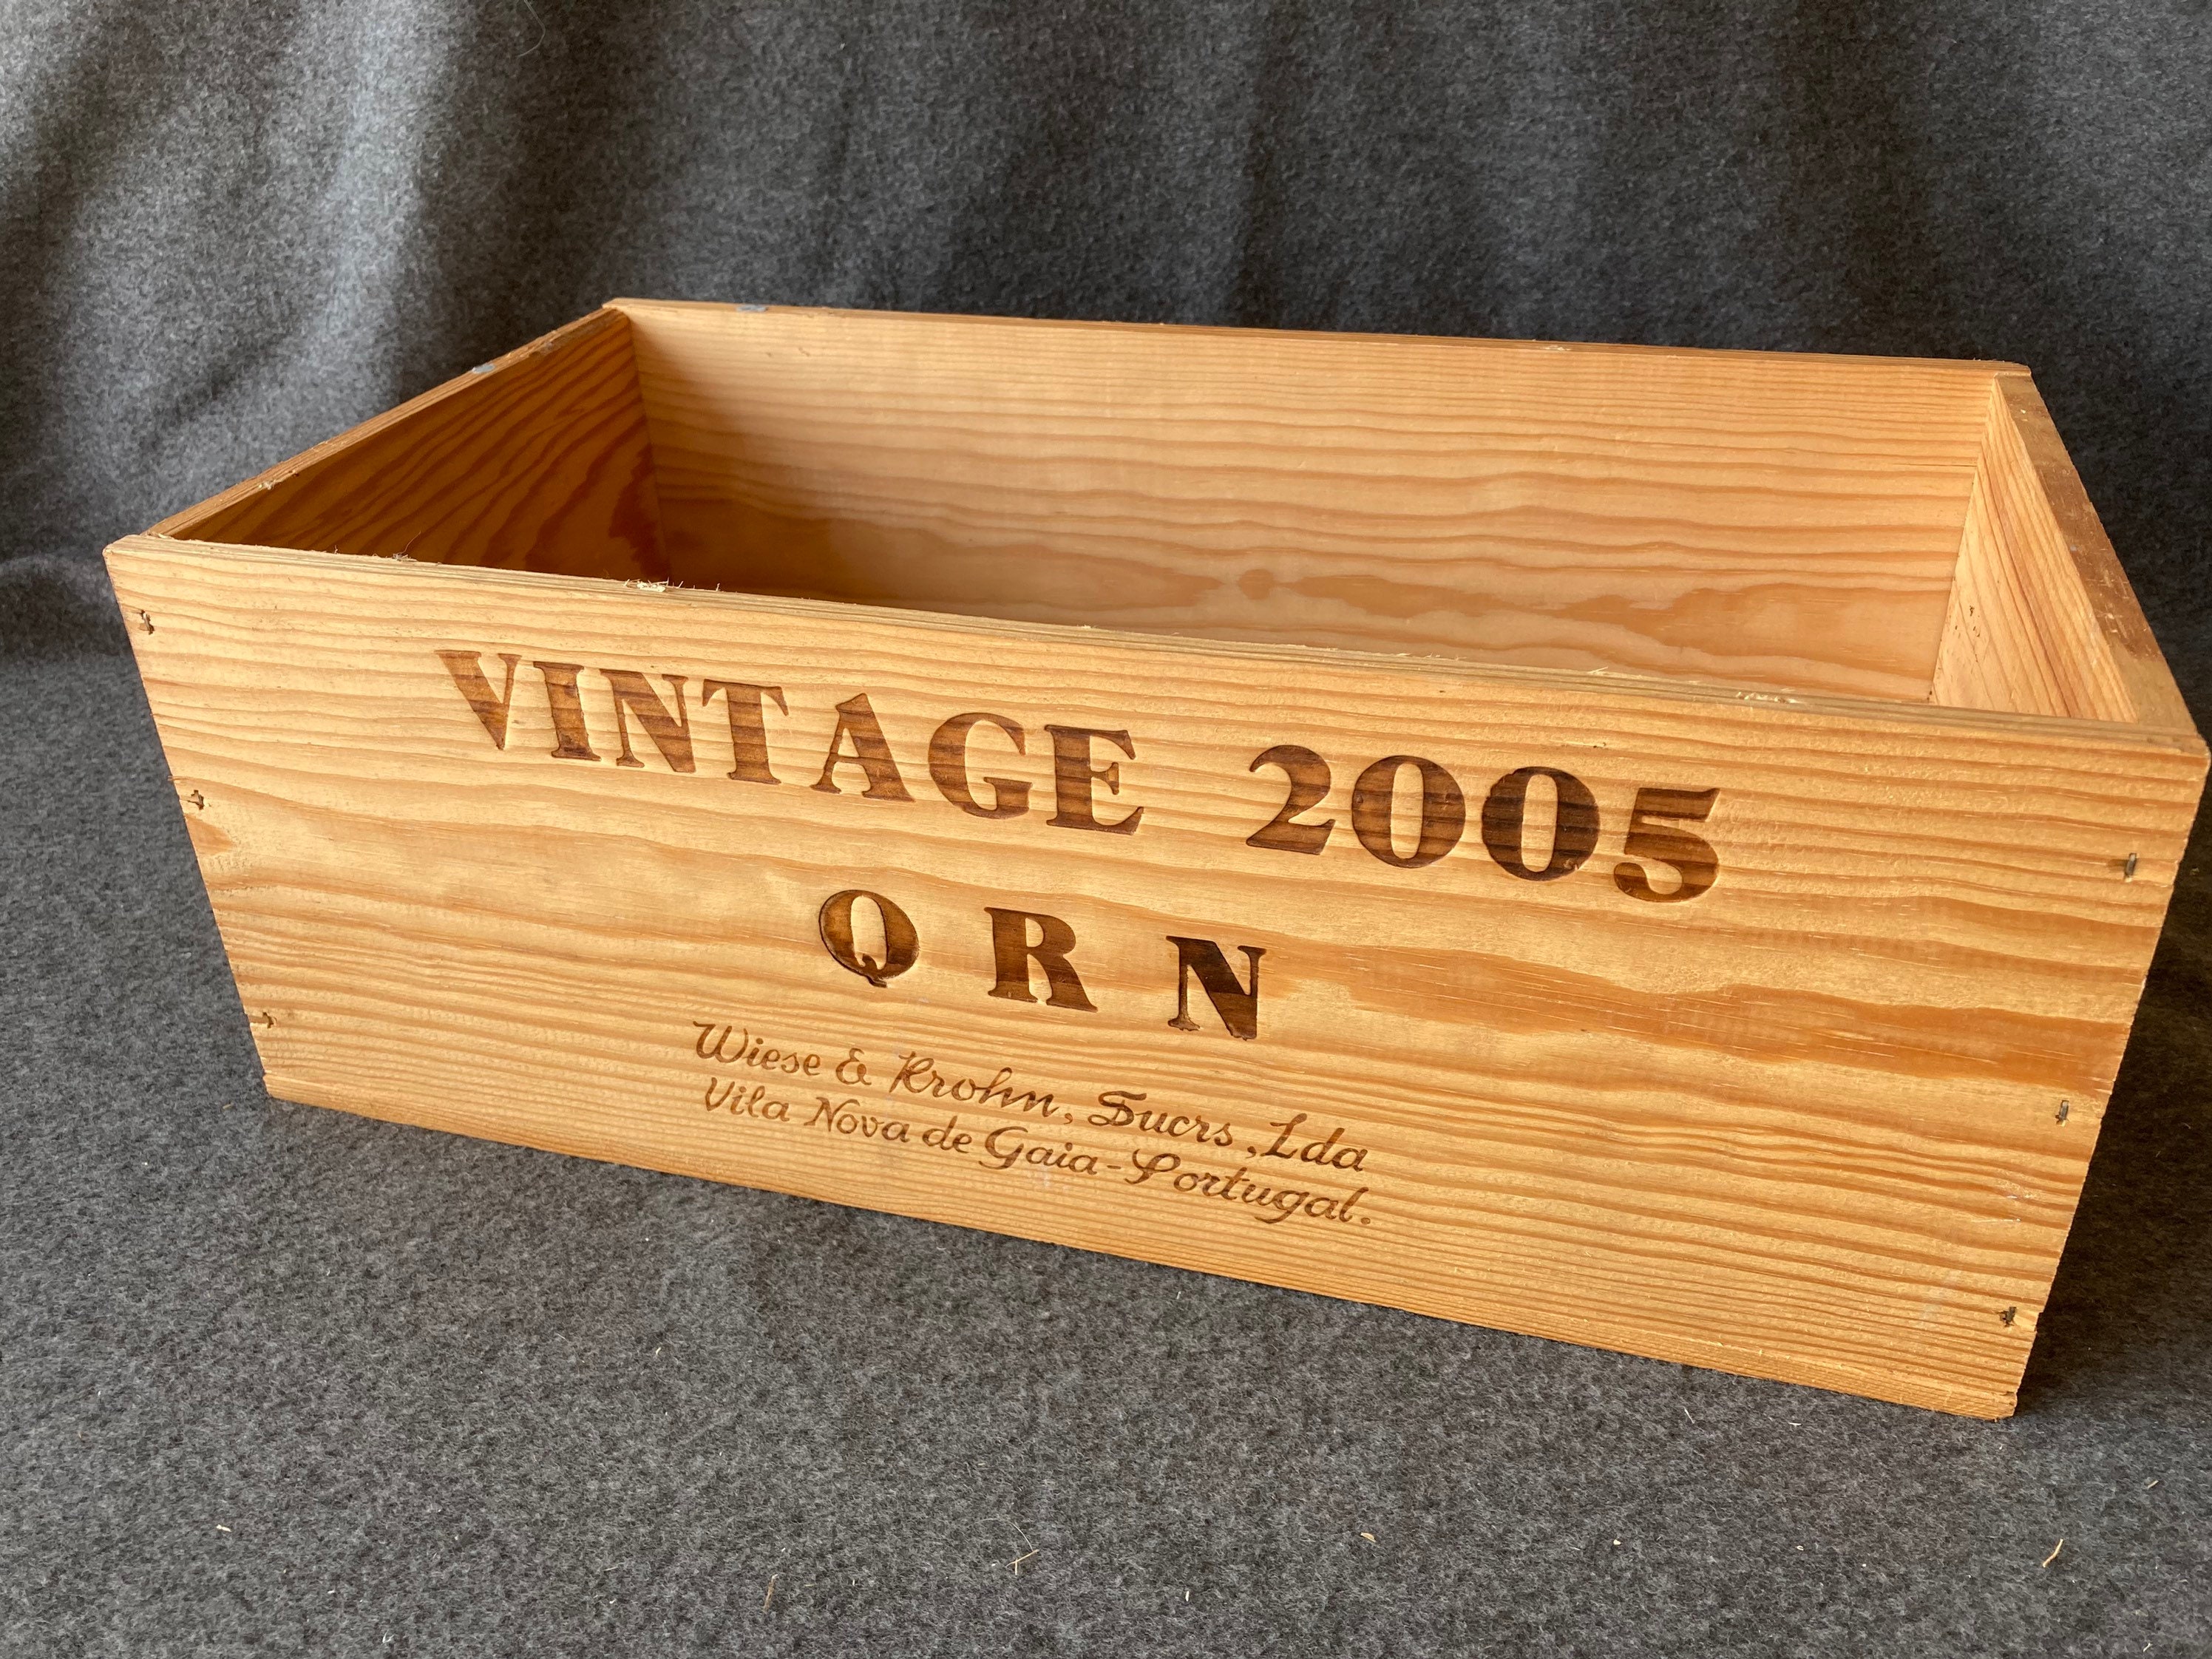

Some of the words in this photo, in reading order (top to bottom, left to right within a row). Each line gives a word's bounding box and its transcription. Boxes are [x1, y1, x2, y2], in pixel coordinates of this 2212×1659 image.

[435, 649, 1144, 835] VINTAGE
[1246, 744, 1720, 903] 2005
[818, 889, 919, 988] Q
[983, 906, 1097, 1011] R
[1166, 935, 1266, 1040] N
[692, 1020, 821, 1076] Wiese
[835, 1048, 872, 1086] &
[704, 1076, 790, 1122] Vila
[804, 1096, 910, 1143] Nova
[922, 1115, 973, 1154] de
